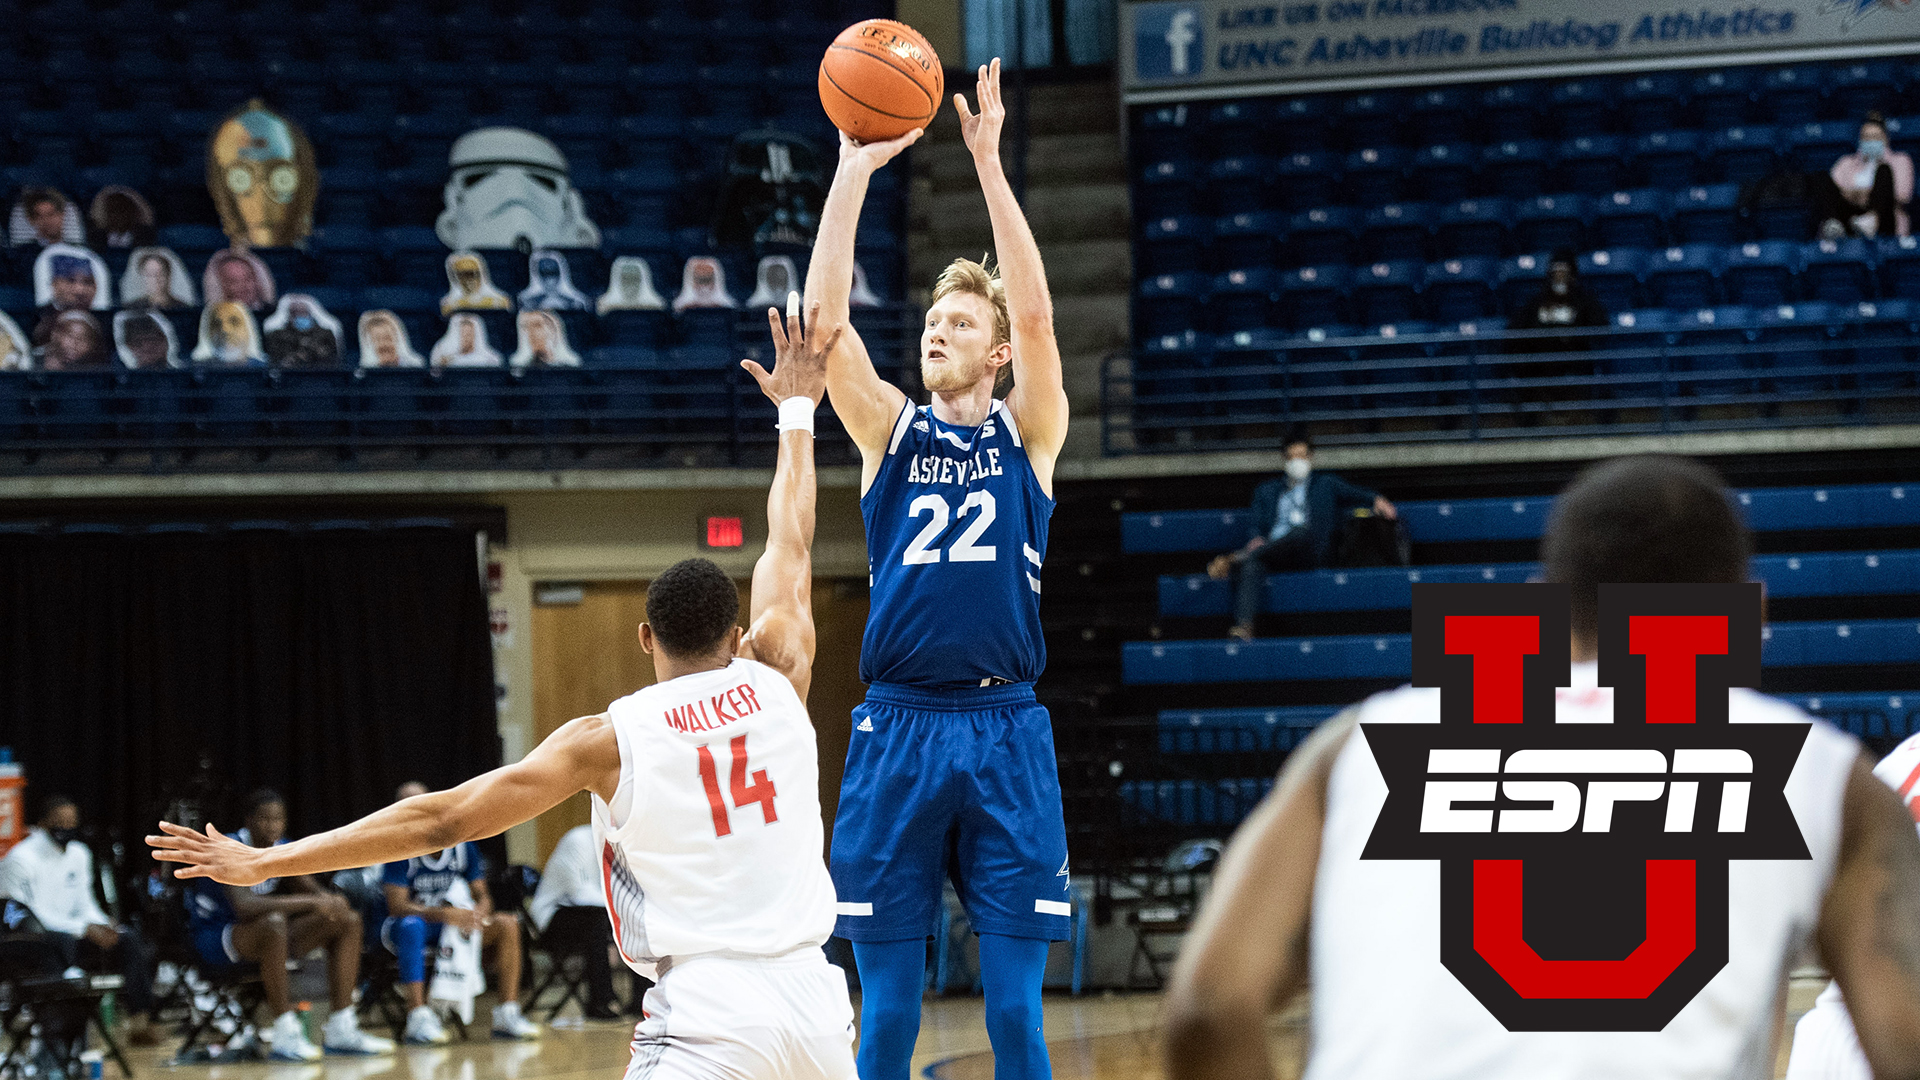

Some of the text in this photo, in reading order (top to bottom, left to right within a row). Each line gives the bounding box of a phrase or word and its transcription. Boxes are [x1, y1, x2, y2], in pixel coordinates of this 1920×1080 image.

[1218, 9, 1796, 70] UNC Asheville Bulldog Athletics
[907, 447, 1003, 488] ASHEVLLE
[902, 489, 997, 566] 22
[664, 683, 762, 734] WALKER
[696, 732, 780, 840] 14
